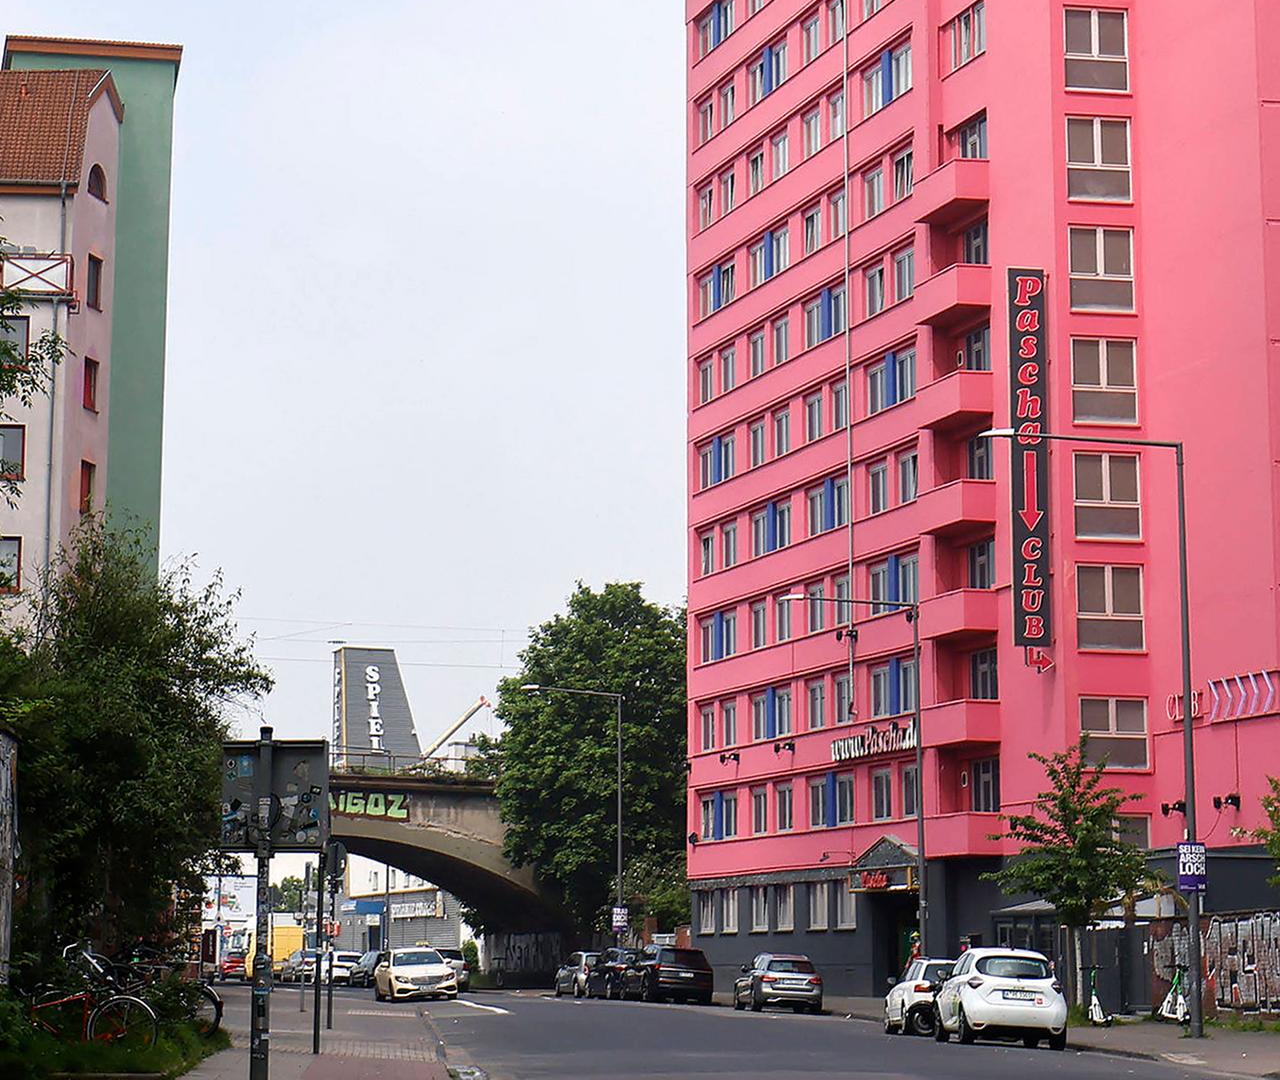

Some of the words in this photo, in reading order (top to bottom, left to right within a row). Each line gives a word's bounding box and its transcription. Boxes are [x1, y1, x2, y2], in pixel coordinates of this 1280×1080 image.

[1015, 275, 1043, 445] Pascha
[1021, 536, 1045, 640] CLUB
[365, 665, 385, 754] SPIEL
[1165, 692, 1199, 721] CLB
[1179, 863, 1206, 875] LOCH
